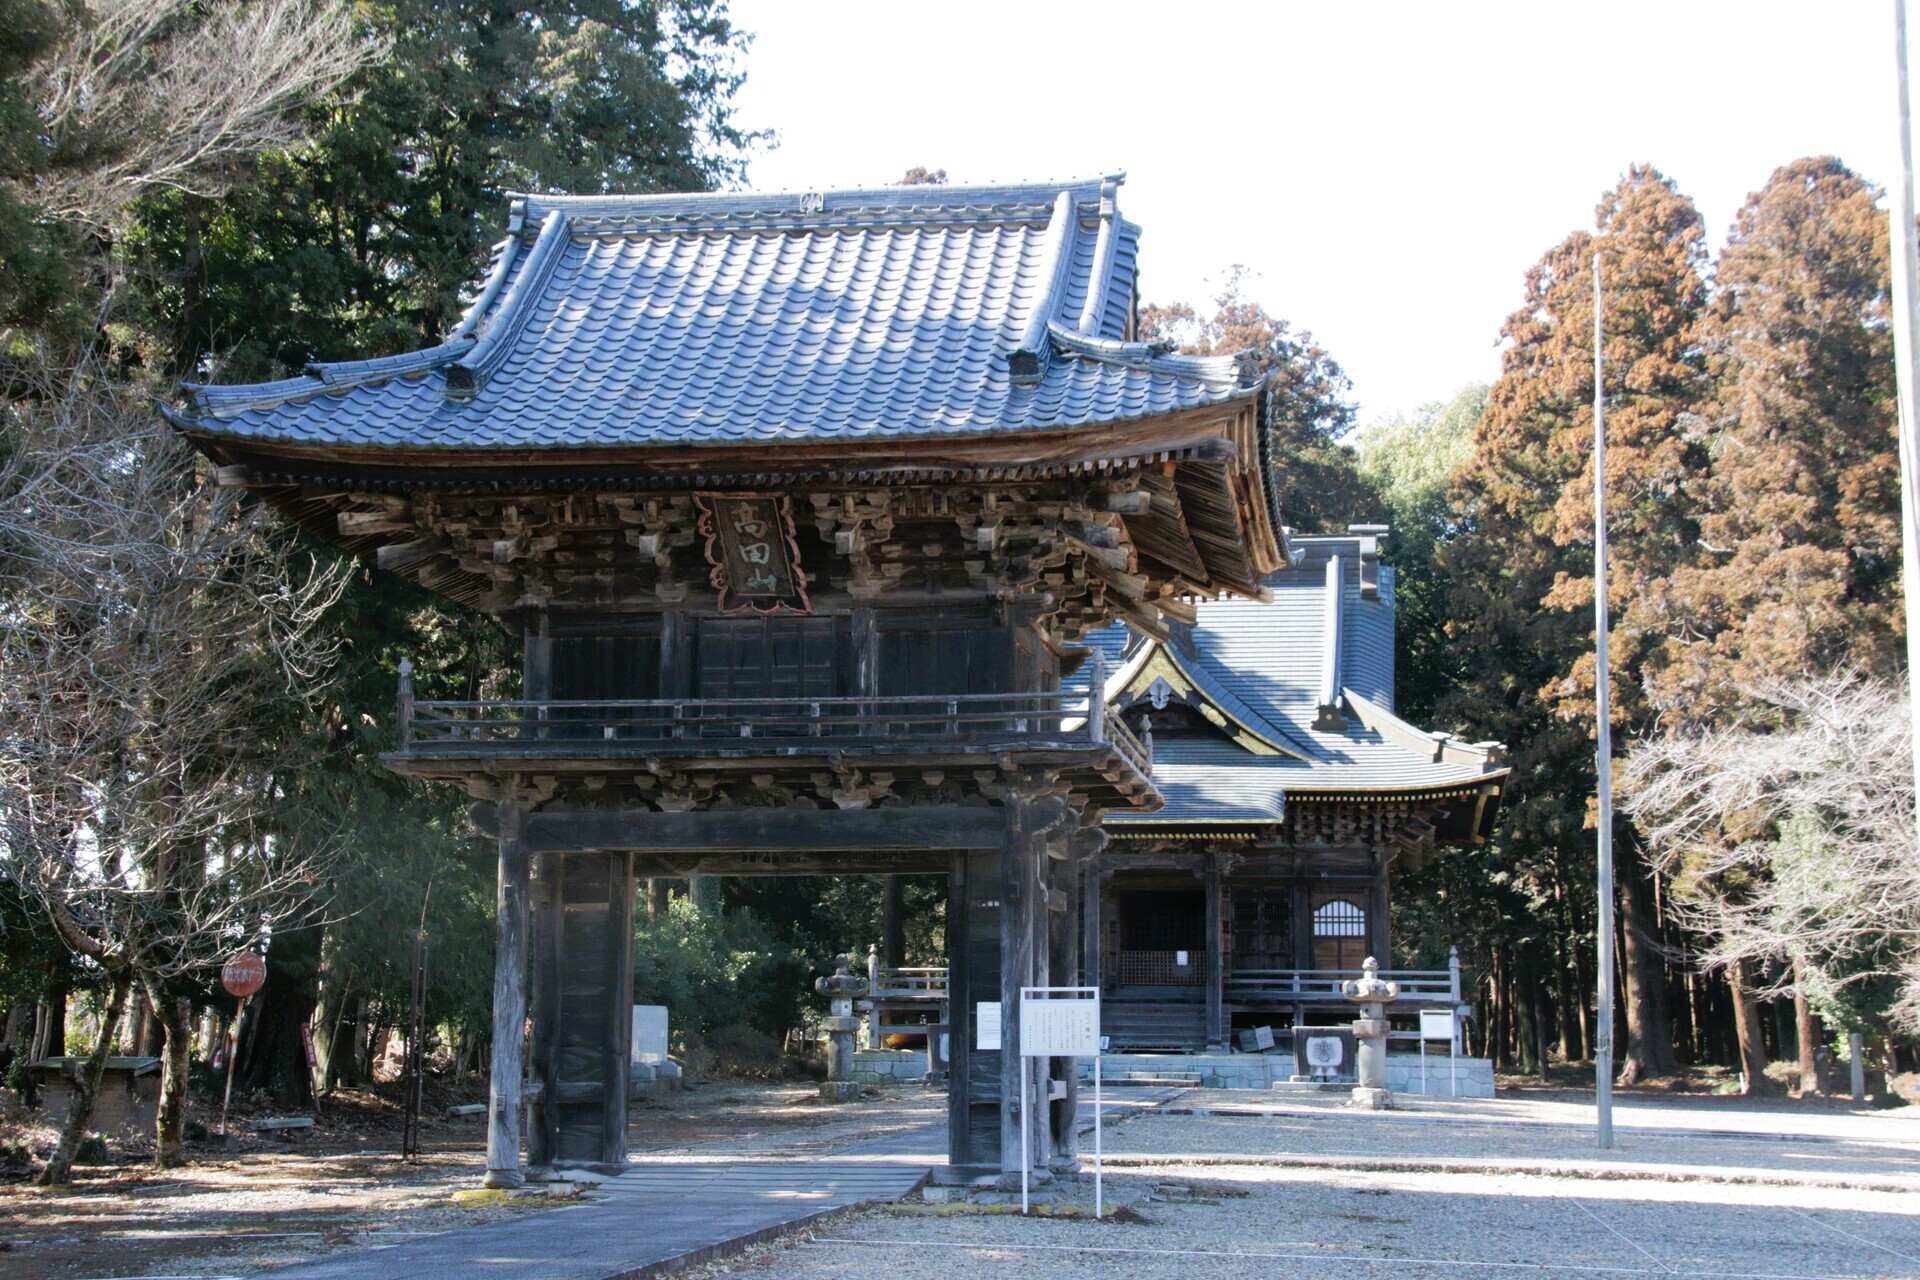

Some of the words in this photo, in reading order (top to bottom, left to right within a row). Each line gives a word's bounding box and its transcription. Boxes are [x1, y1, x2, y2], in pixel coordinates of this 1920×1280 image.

[224, 966, 262, 983] 防火水そう
